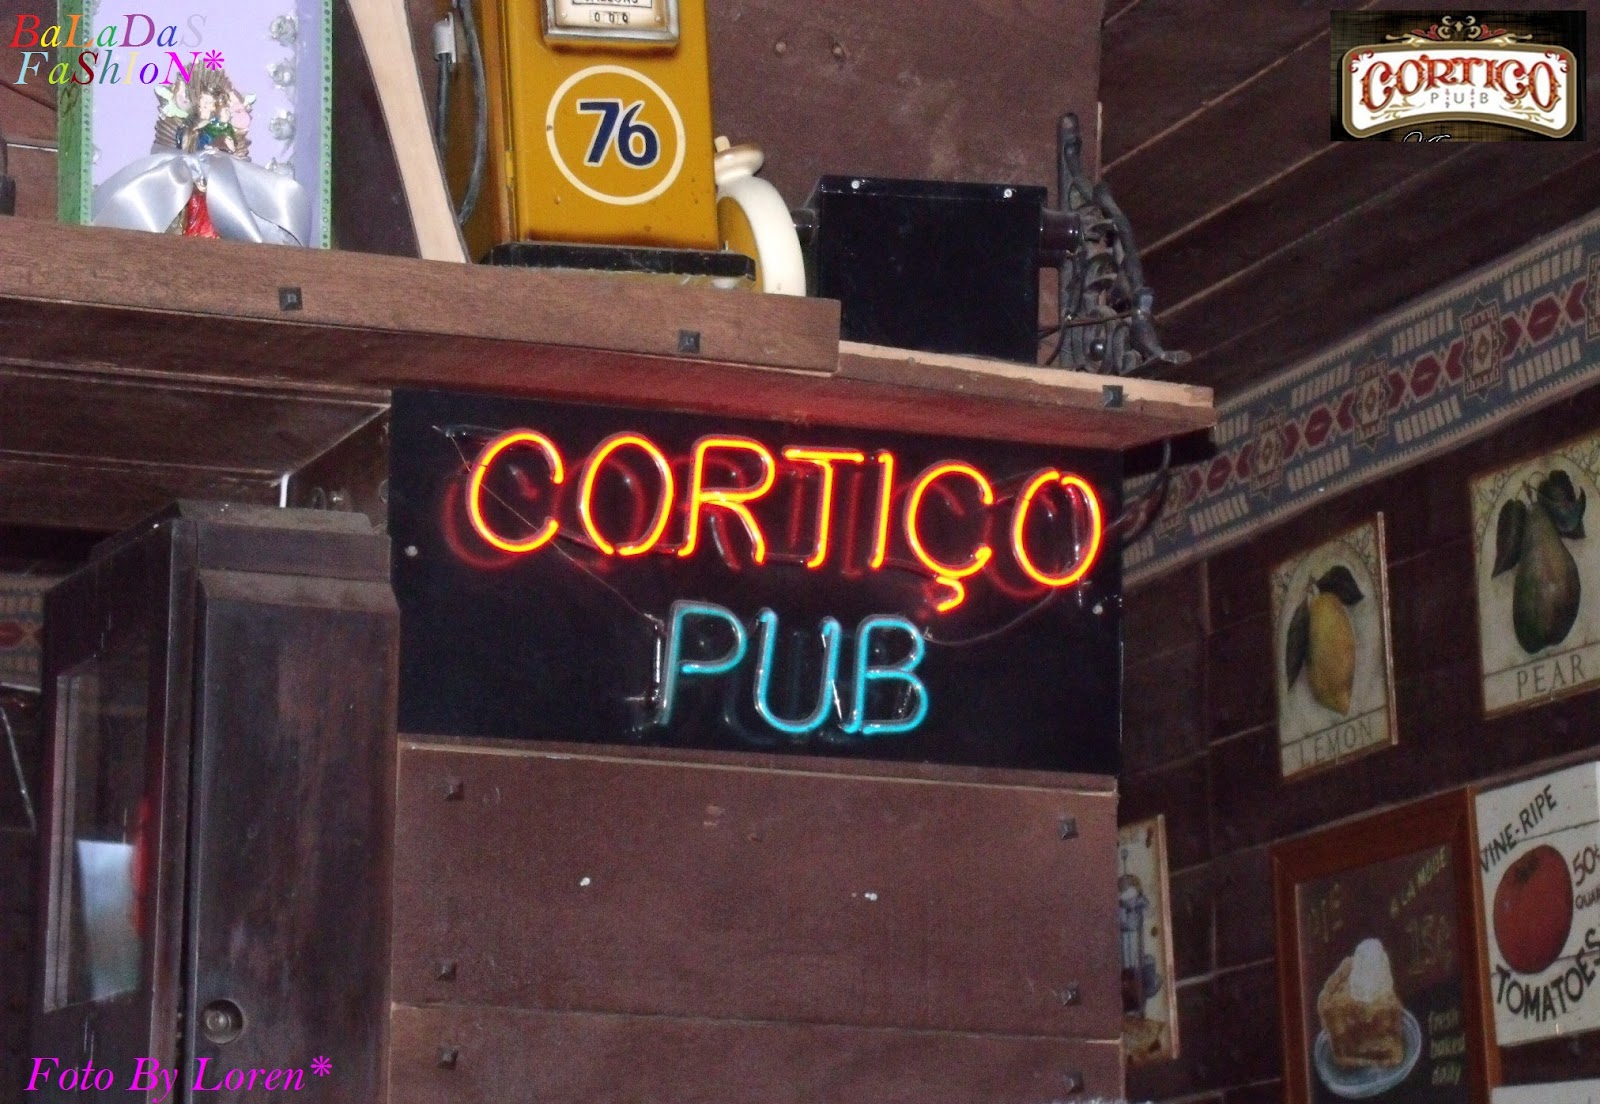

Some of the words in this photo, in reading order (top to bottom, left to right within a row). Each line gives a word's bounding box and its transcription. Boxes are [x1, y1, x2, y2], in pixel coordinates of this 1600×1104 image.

[576, 98, 661, 170] 76
[468, 426, 1103, 613] CORTIÇO
[654, 600, 930, 736] PUB
[1516, 653, 1587, 699] PEAR
[1297, 717, 1373, 768] LEMON
[1479, 784, 1558, 874] VINE-RIPE
